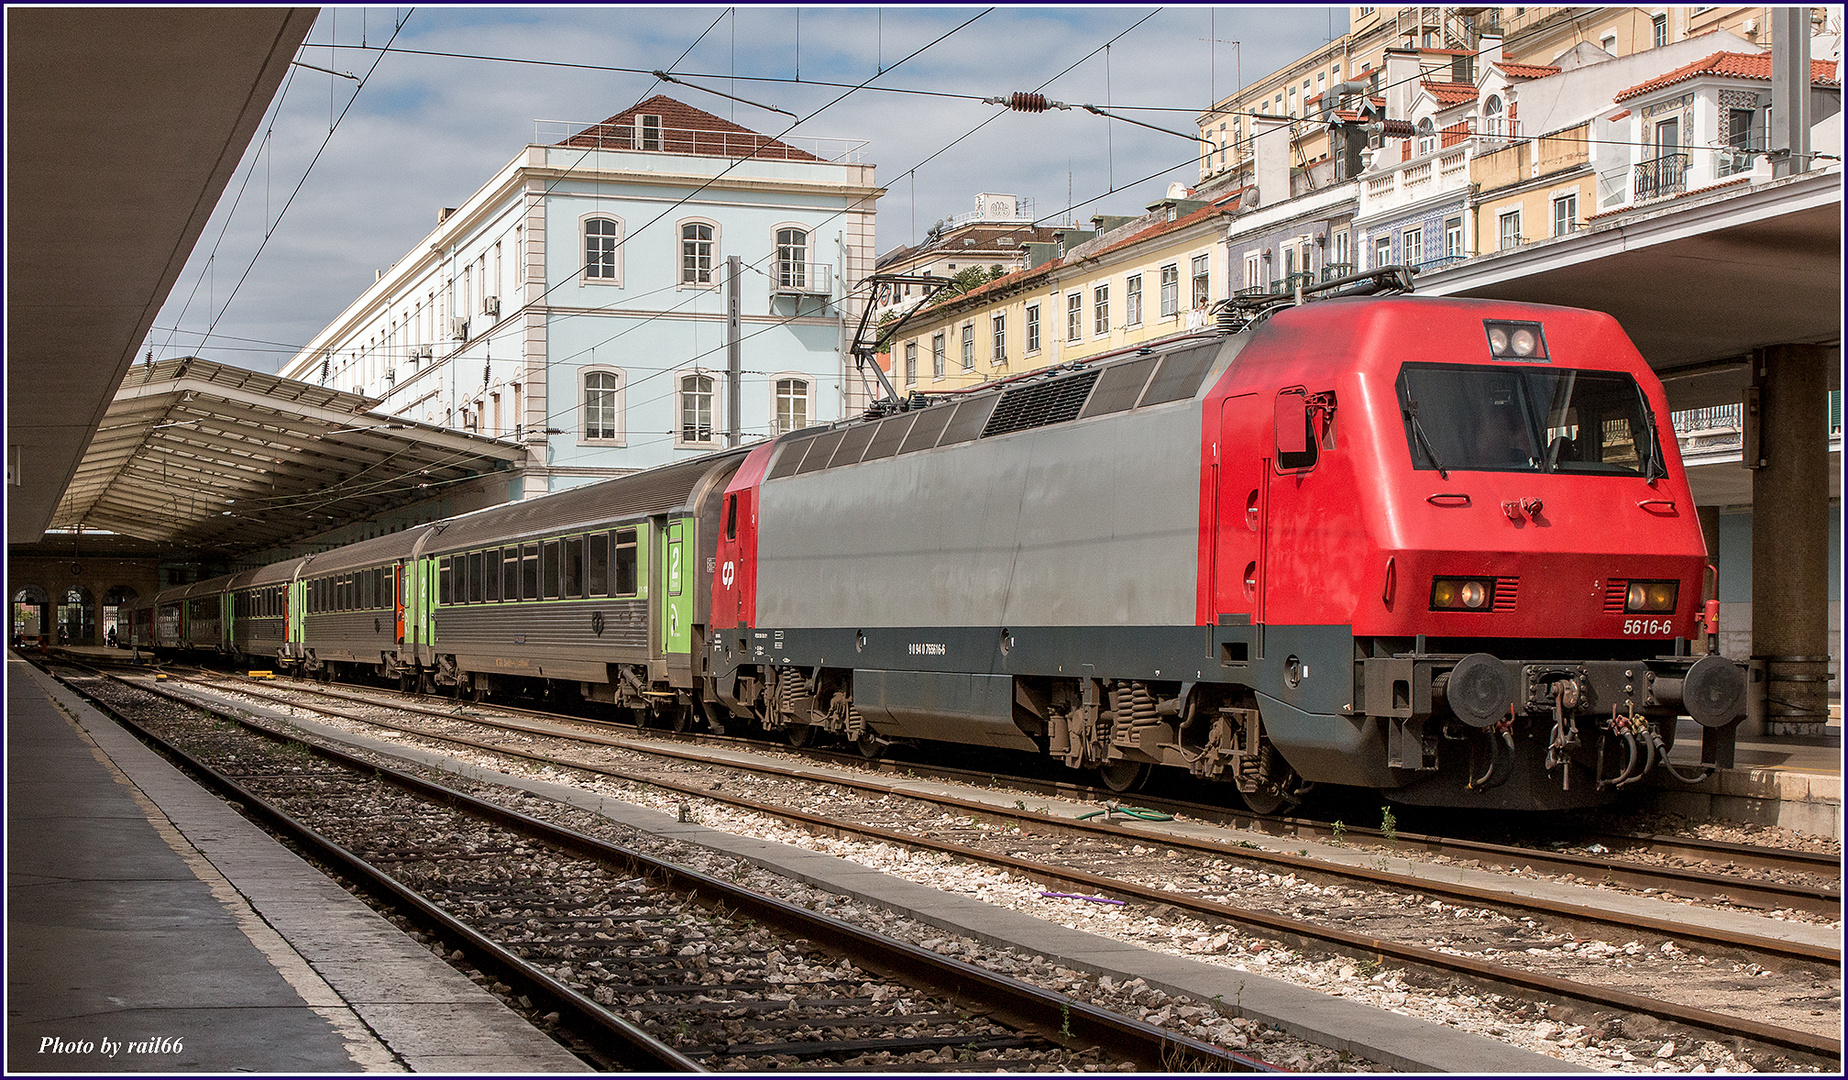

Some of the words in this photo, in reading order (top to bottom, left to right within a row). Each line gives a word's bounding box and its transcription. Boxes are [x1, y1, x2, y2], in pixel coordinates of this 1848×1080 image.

[1212, 442, 1216, 457] 1
[672, 546, 679, 579] 2
[421, 577, 426, 598] 2
[1623, 619, 1672, 635] 5616-6
